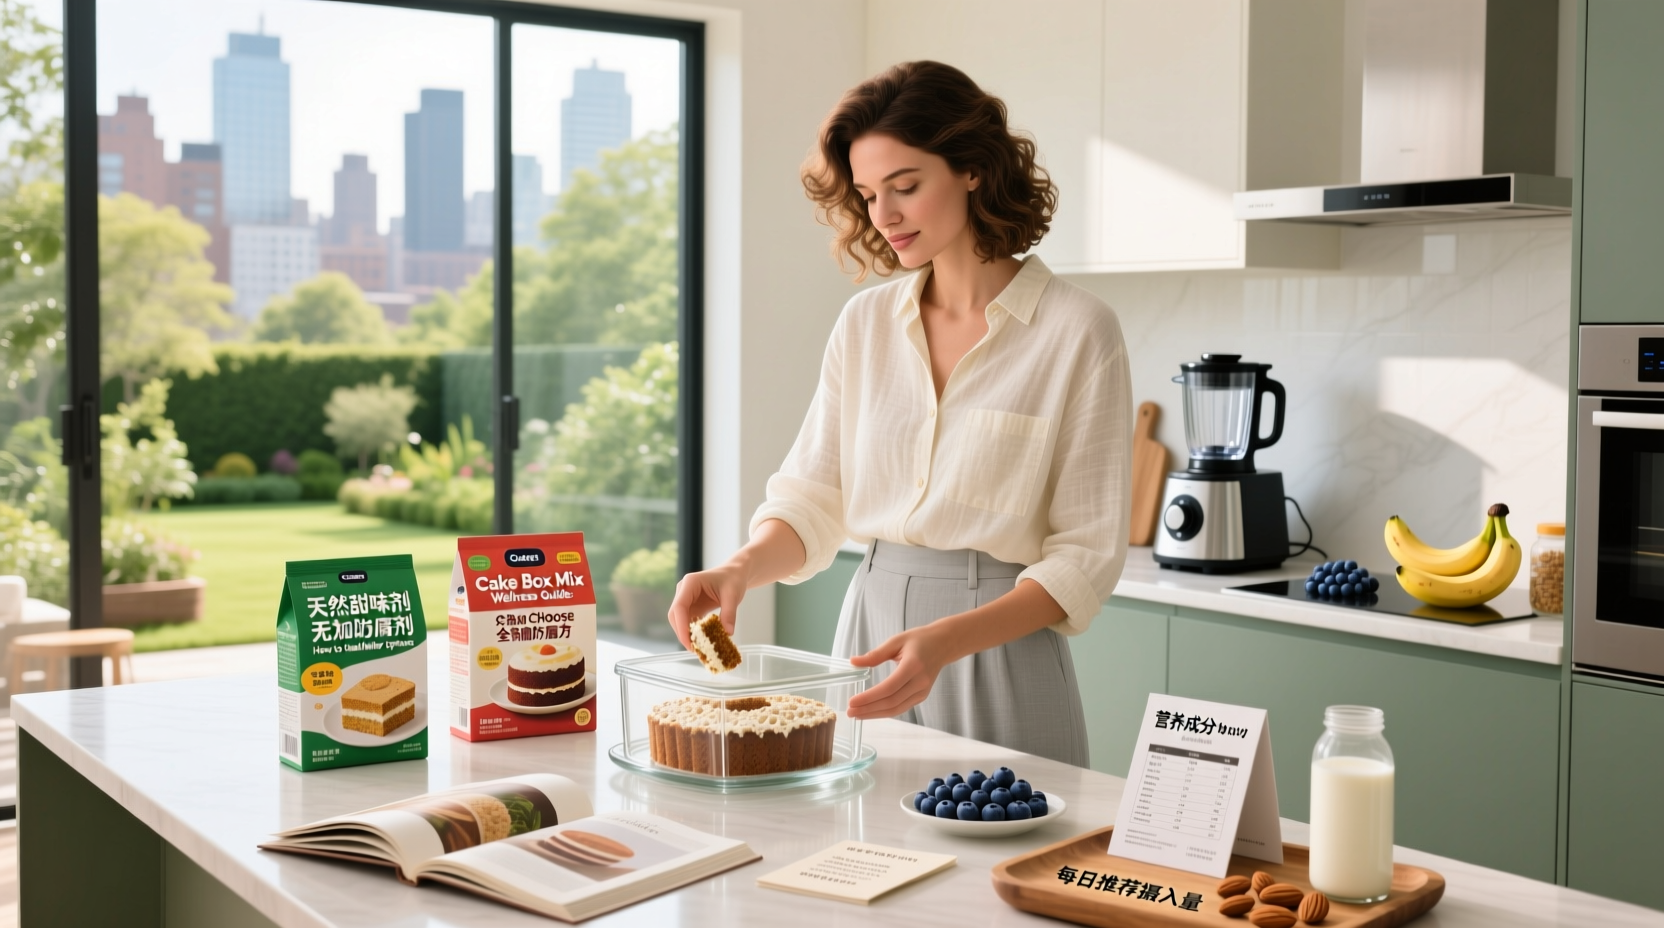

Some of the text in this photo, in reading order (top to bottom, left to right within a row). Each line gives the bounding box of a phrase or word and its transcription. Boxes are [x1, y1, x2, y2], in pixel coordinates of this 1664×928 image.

[475, 571, 585, 592] Cake Box Mix
[307, 590, 411, 619] 天然甜味剂
[1154, 709, 1217, 736] 营养成分
[1057, 865, 1204, 912] 每日推荐摄入量
